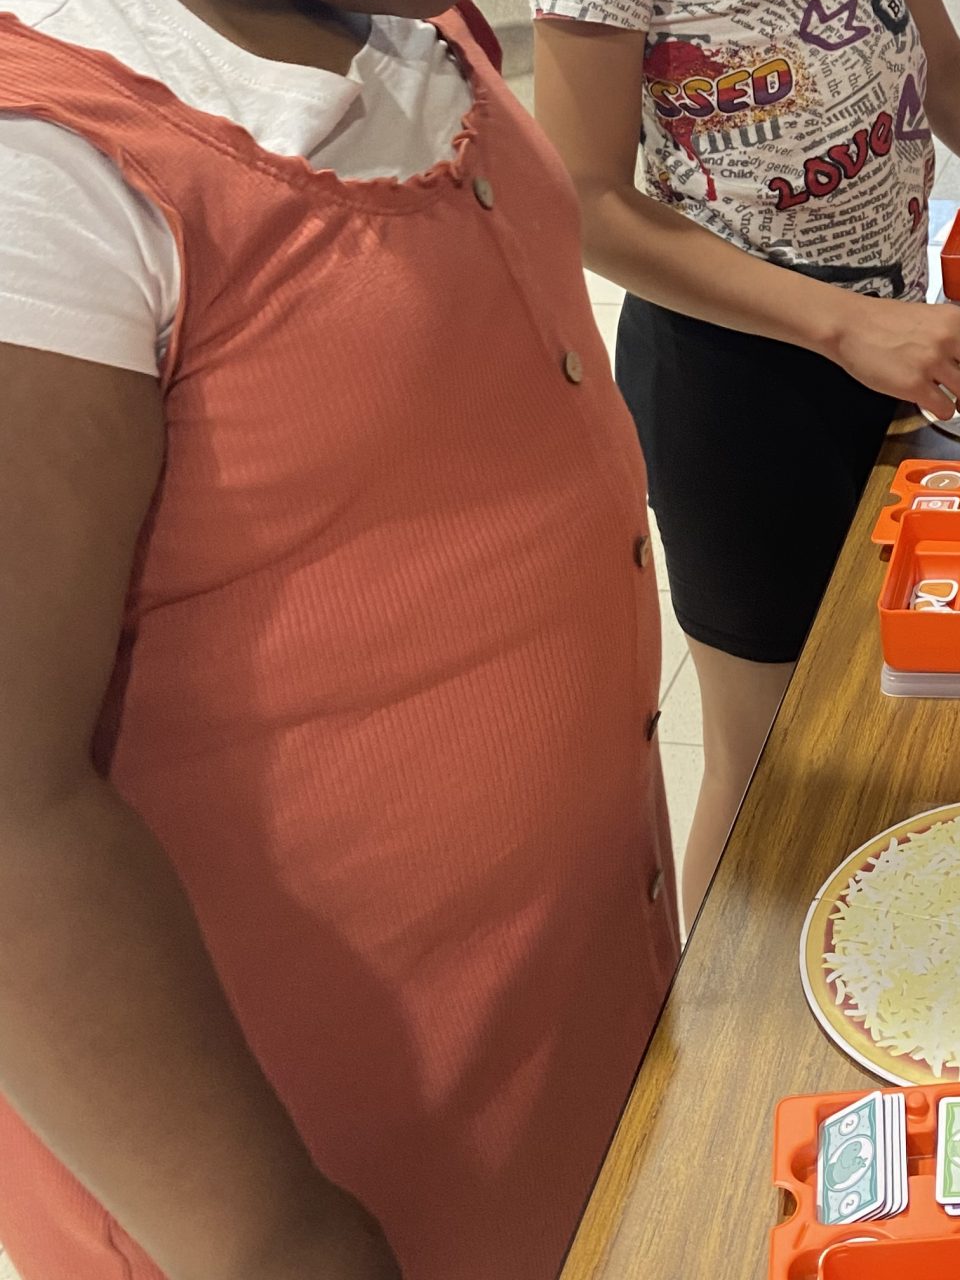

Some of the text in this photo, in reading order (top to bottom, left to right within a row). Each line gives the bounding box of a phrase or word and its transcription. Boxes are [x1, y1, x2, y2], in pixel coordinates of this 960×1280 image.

[797, 233, 828, 248] back
[832, 226, 857, 240] and
[816, 241, 846, 258] pose
[857, 248, 883, 266] only
[938, 478, 950, 487] 1
[845, 1119, 855, 1129] 2
[845, 1199, 855, 1208] 2
